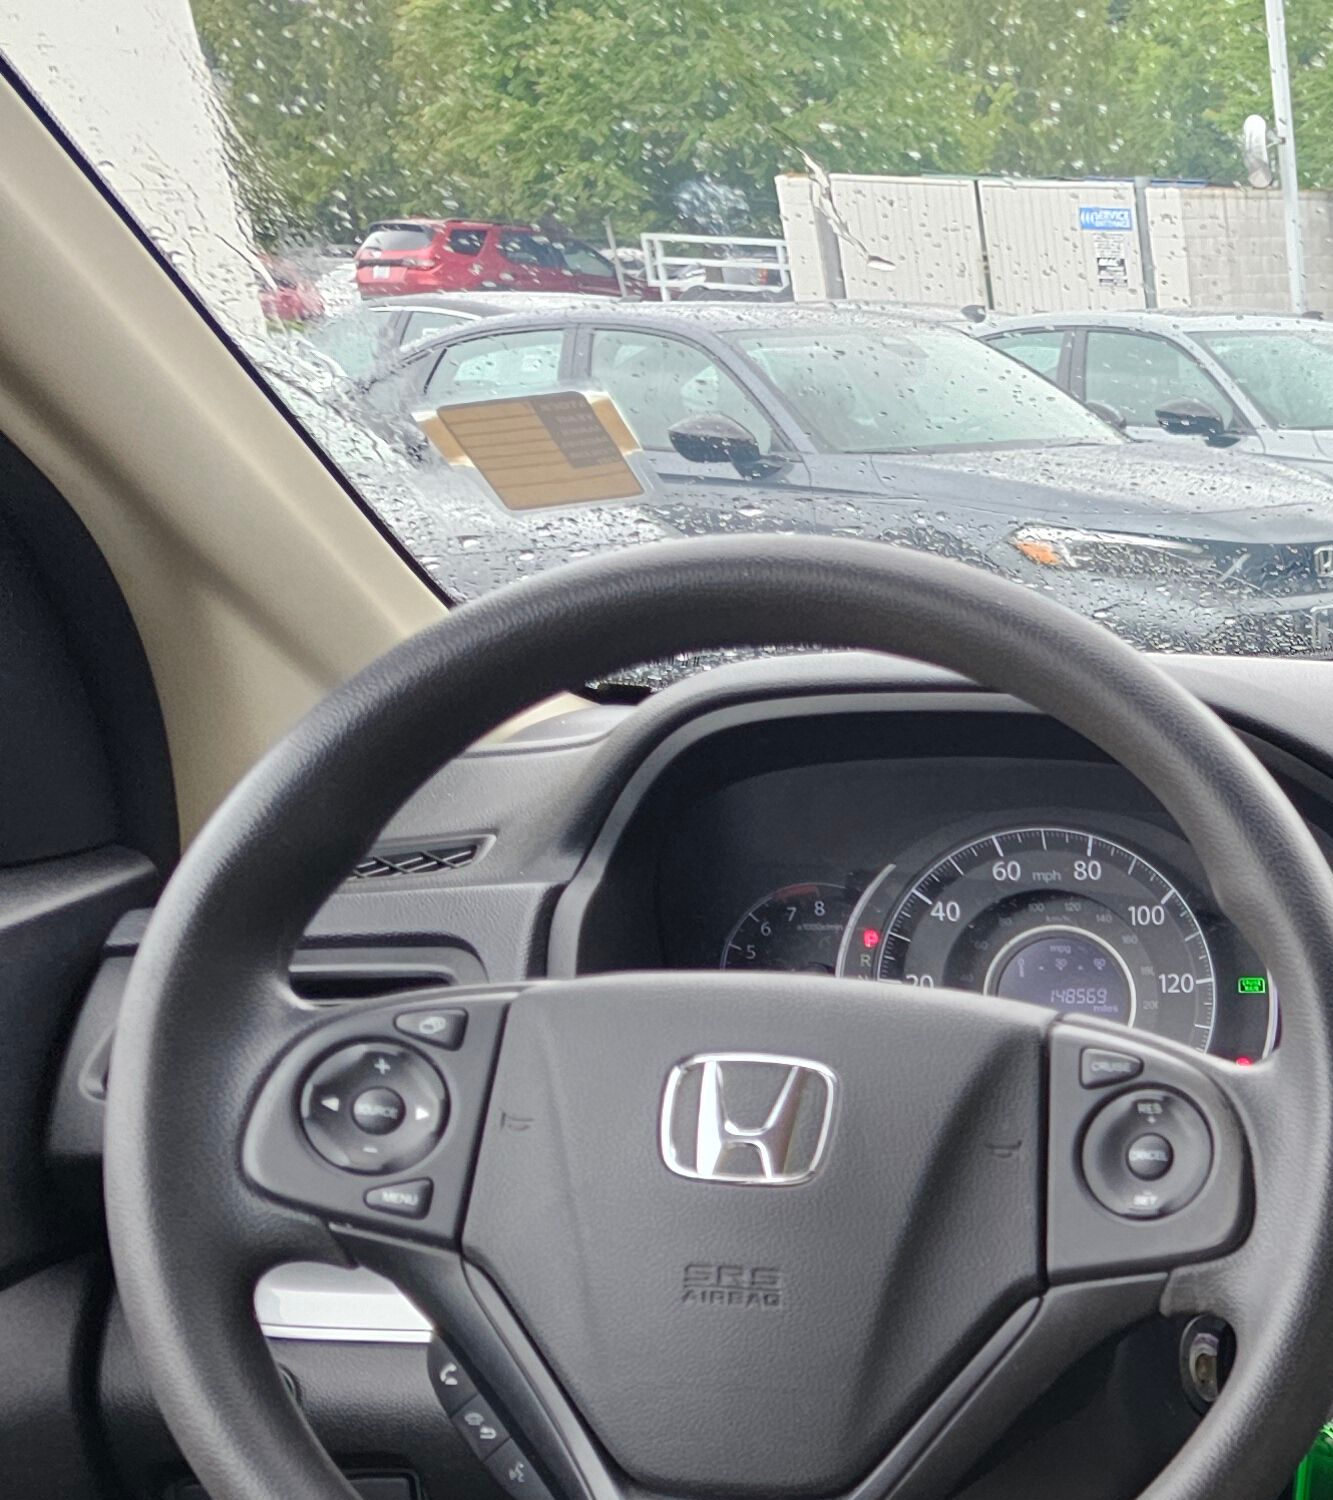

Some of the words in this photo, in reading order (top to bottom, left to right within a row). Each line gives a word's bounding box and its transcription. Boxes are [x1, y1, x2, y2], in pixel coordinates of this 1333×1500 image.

[992, 861, 1022, 881] 60
[1032, 871, 1061, 885] mph
[1073, 861, 1102, 881] 80
[786, 907, 798, 922] 7
[813, 901, 826, 916] 8
[930, 902, 961, 922] 40
[1128, 905, 1165, 926] 100
[760, 923, 771, 937] 6
[863, 929, 879, 947] P
[744, 944, 756, 960] 5
[860, 954, 872, 967] R
[1158, 973, 1195, 994] 120
[1050, 988, 1108, 1005] 148569
[381, 1189, 419, 1206] MENU
[683, 1263, 782, 1288] SRS
[680, 1288, 782, 1308] AIRBAG
